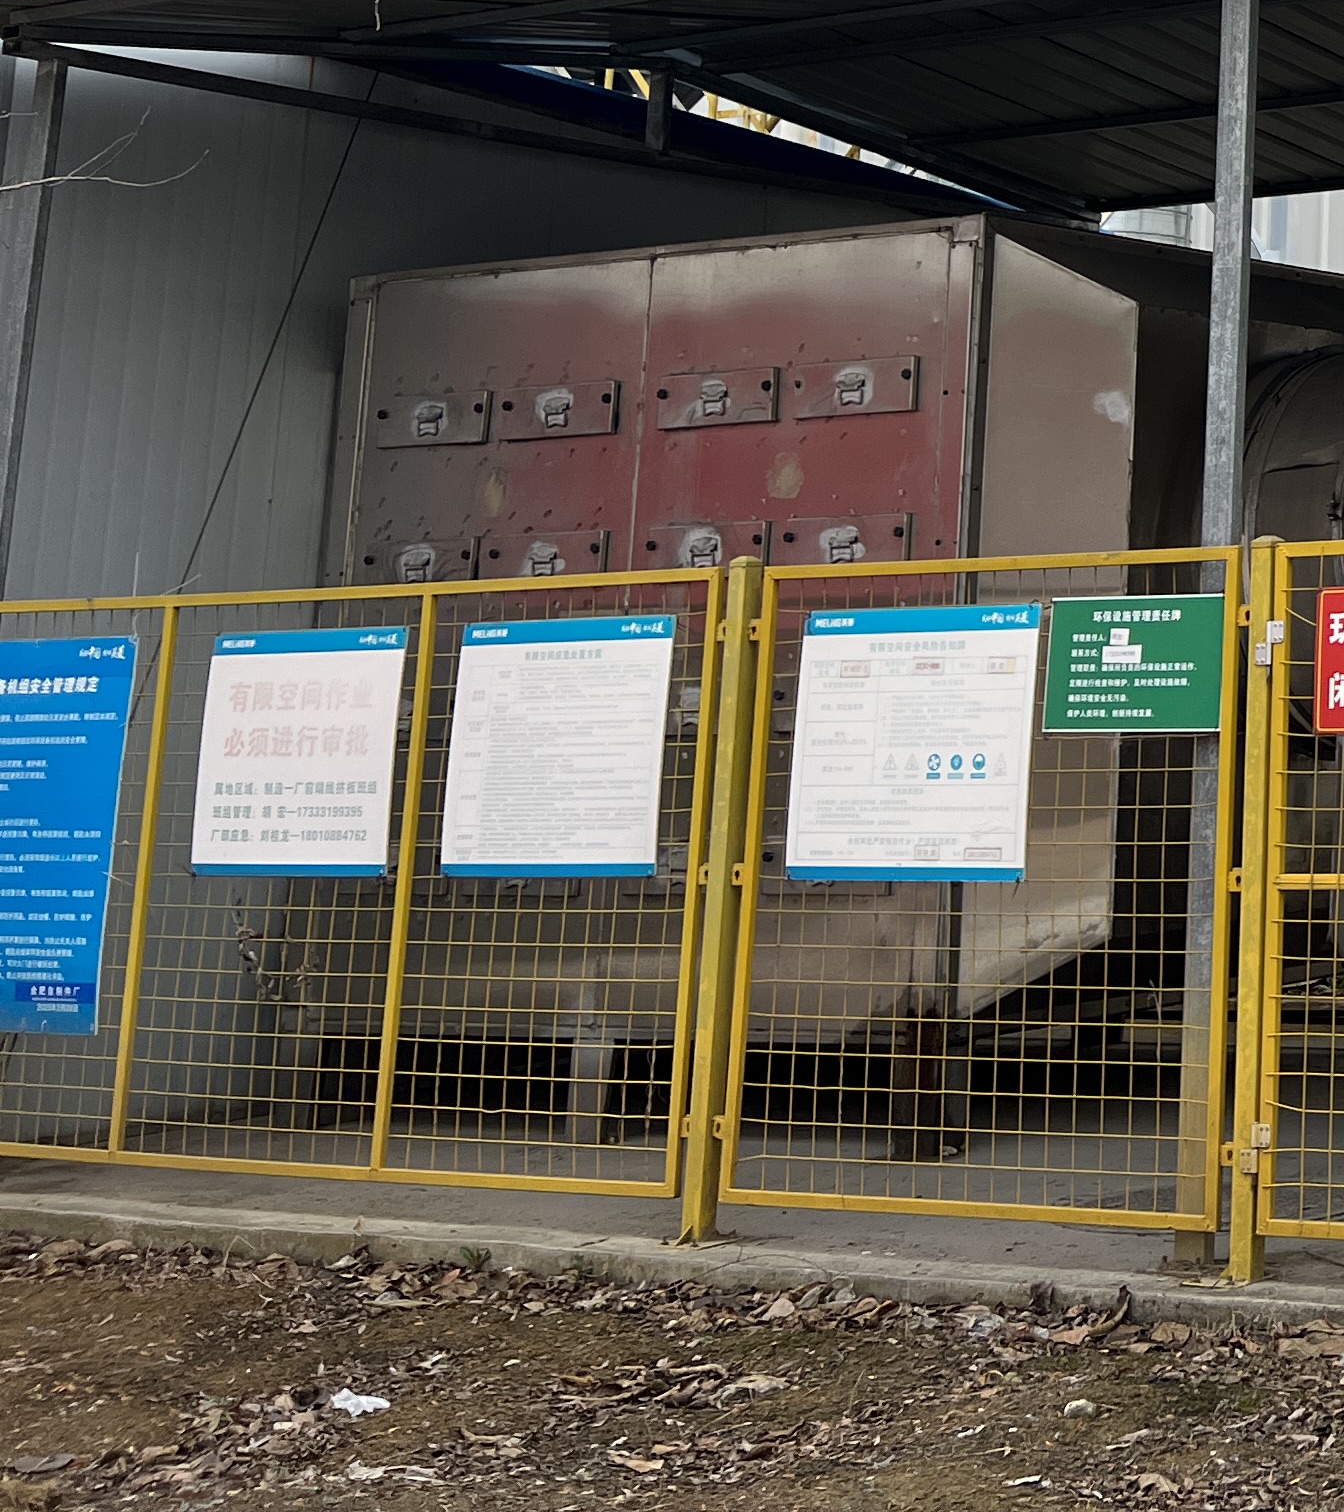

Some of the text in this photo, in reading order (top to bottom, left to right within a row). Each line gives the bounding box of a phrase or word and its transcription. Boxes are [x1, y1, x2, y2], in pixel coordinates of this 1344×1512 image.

[229, 679, 374, 713] 有限空间作业
[224, 725, 369, 758] 必须进行审批
